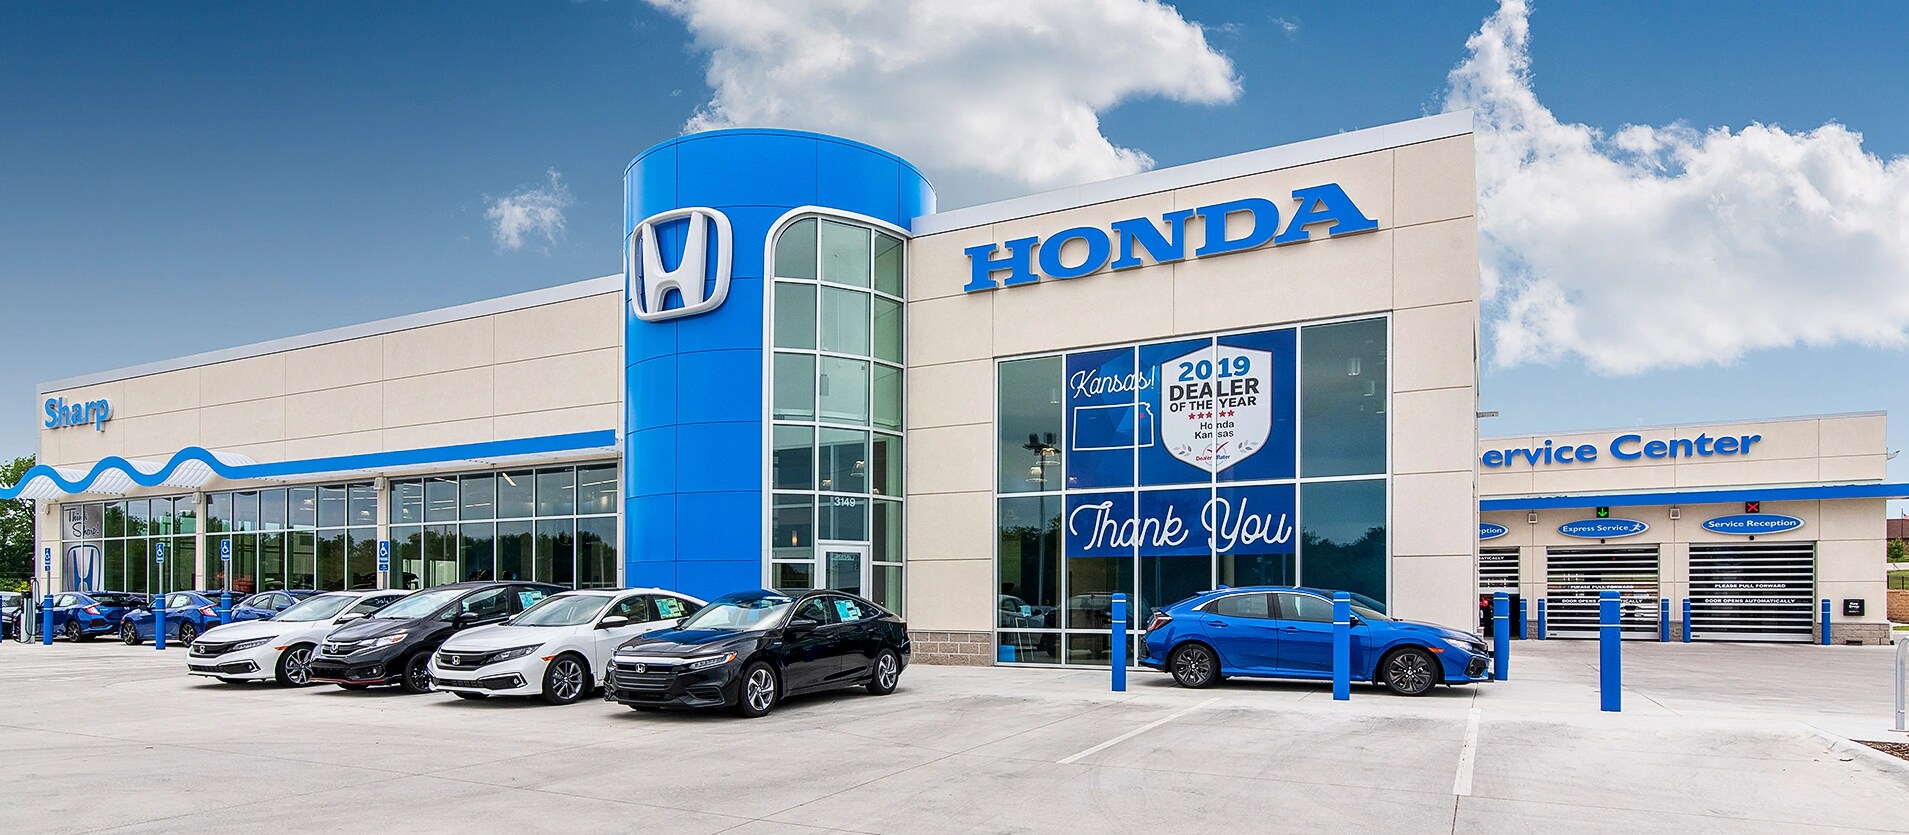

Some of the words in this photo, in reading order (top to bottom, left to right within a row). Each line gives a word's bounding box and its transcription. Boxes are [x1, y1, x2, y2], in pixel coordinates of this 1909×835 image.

[964, 183, 1379, 293] HONDA
[1070, 365, 1155, 398] Kansas!
[1178, 356, 1251, 382] 2019
[1169, 377, 1260, 402] DEALER
[44, 397, 112, 432] Sharp
[1169, 401, 1186, 413] OF
[1189, 400, 1213, 411] THE
[1218, 396, 1257, 408] YEAR
[1194, 430, 1234, 440] Kansas
[1200, 420, 1235, 430] Honda
[1481, 439, 1598, 468] ervice
[1609, 432, 1763, 461] Center
[834, 497, 856, 507] 3149
[1069, 501, 1189, 551] Thank
[1201, 497, 1292, 553] You
[1562, 525, 1595, 533] Express
[1596, 524, 1629, 532] Service
[1746, 519, 1797, 528] Reception
